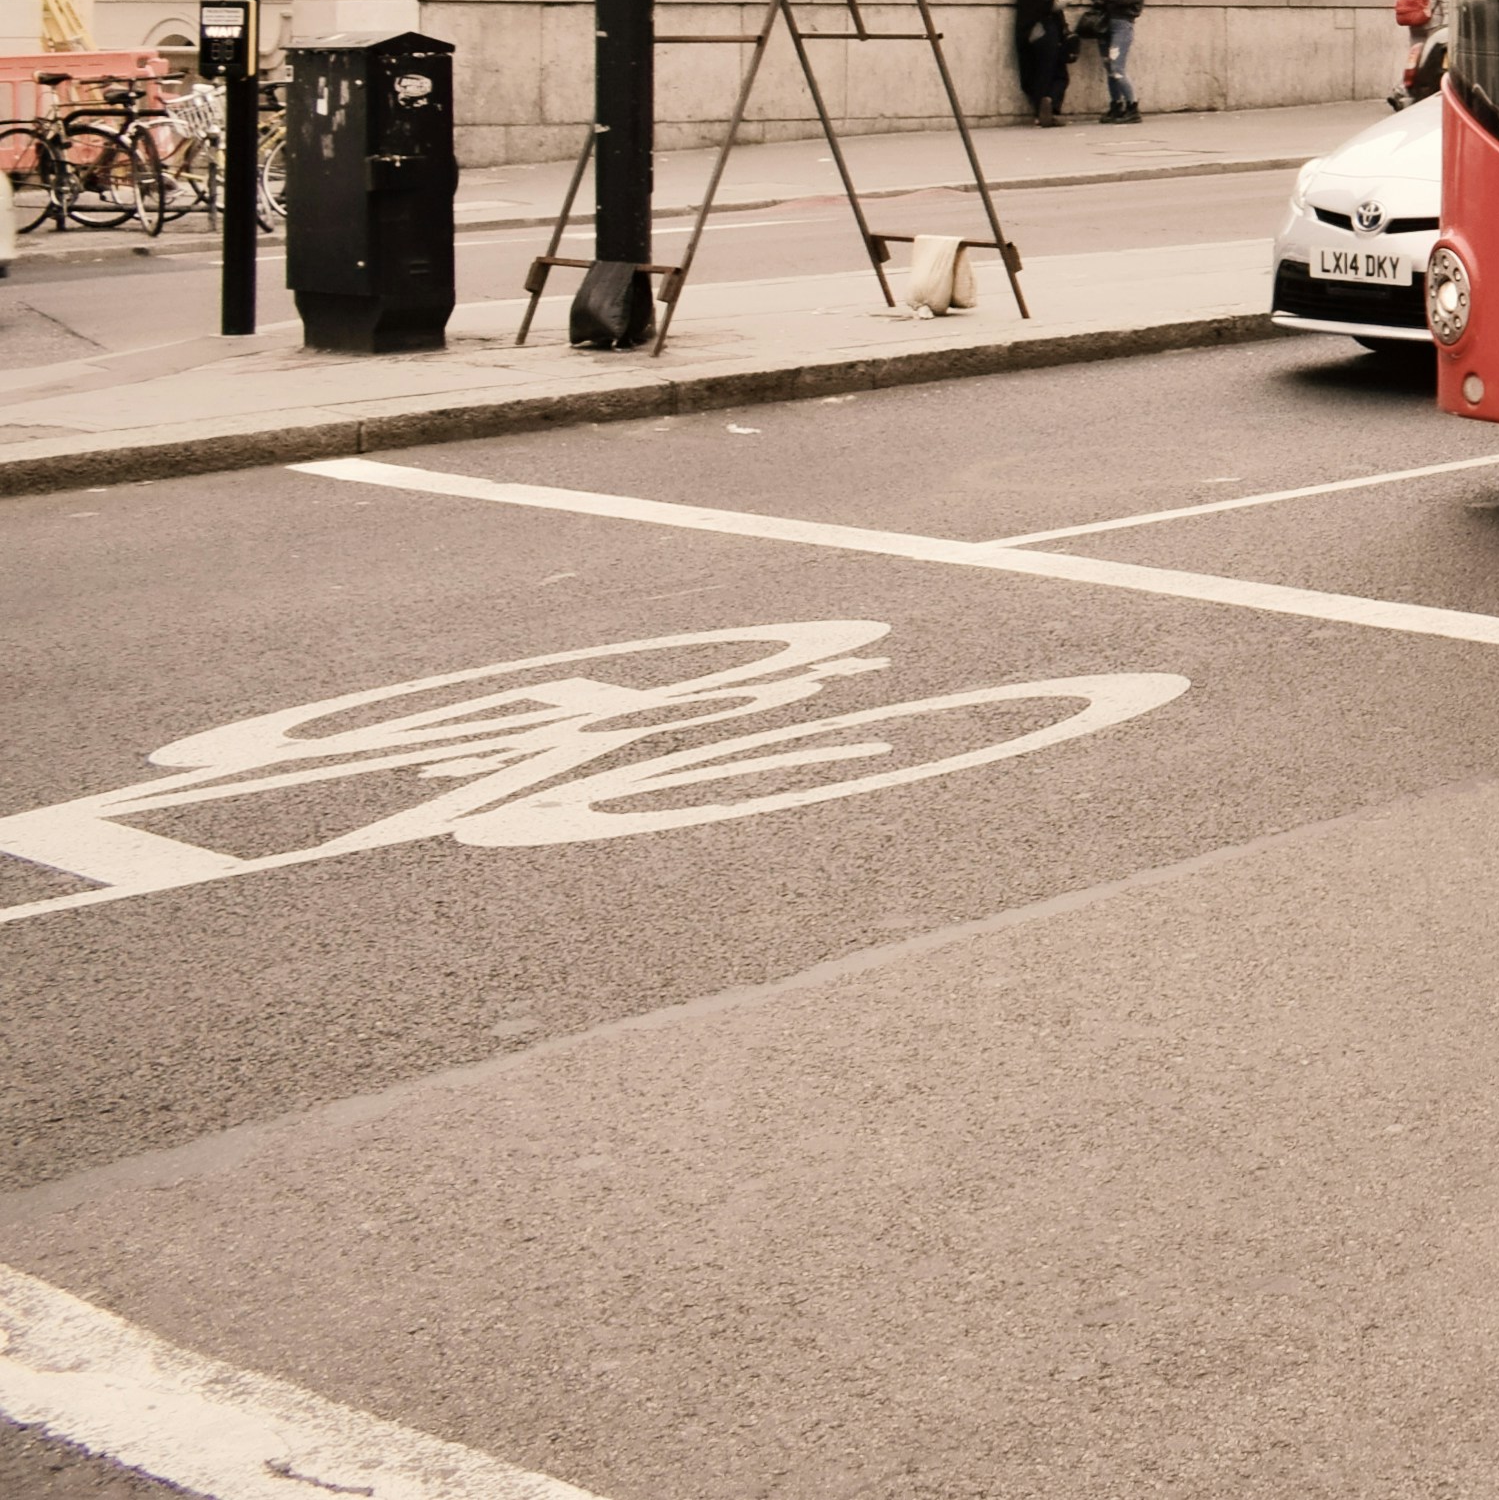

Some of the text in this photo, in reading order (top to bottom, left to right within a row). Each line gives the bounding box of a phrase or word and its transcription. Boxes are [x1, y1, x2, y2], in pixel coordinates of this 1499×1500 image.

[204, 26, 242, 38] WAIT
[1320, 250, 1400, 280] LX14 DKY
